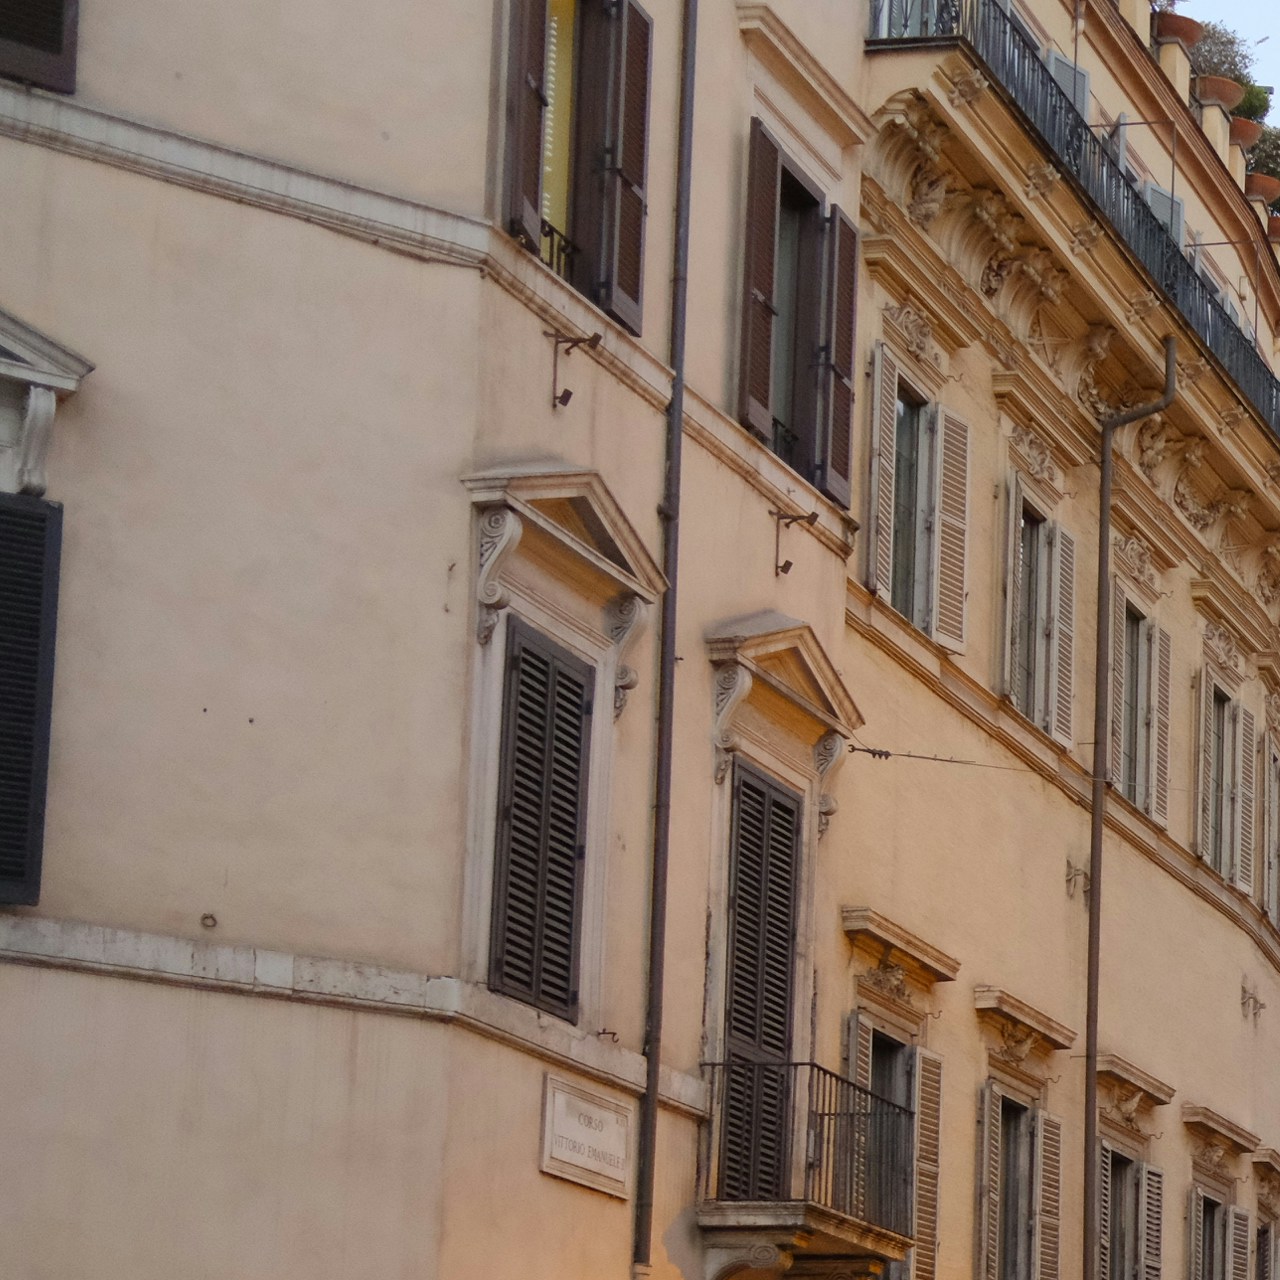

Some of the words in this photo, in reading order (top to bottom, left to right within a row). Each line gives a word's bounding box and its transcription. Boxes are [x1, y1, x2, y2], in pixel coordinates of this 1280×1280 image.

[577, 1113, 604, 1132] CORSO
[554, 1134, 585, 1156] VITTORIO
[588, 1145, 620, 1169] EMANUELE
